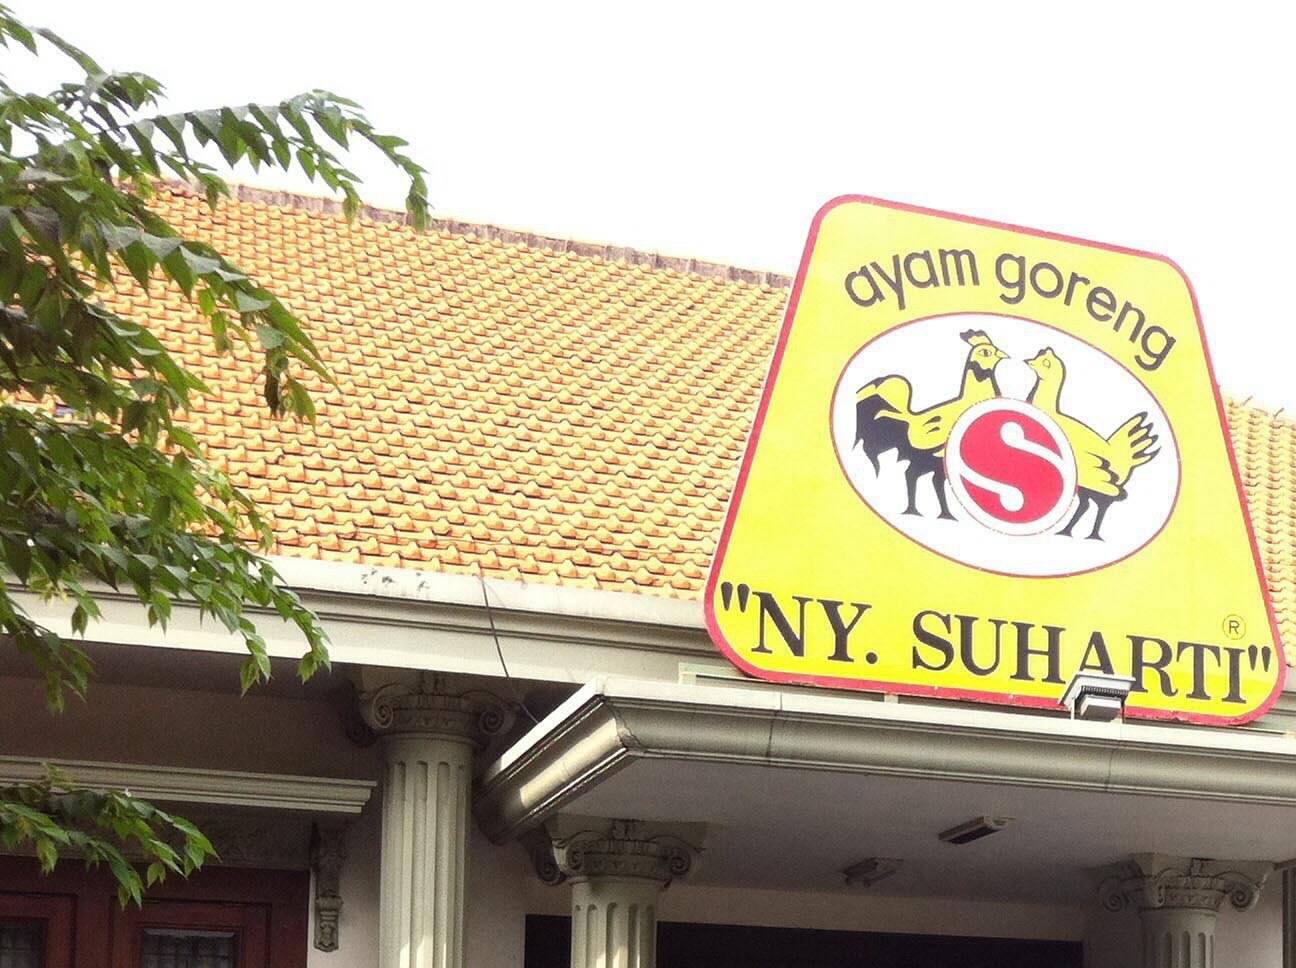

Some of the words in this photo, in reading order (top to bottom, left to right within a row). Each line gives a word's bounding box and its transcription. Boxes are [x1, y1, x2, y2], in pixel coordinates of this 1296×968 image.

[844, 248, 979, 310] ayam
[995, 252, 1177, 373] goreng
[720, 581, 878, 665] "NY.
[911, 609, 1272, 705] SUHARTI"
